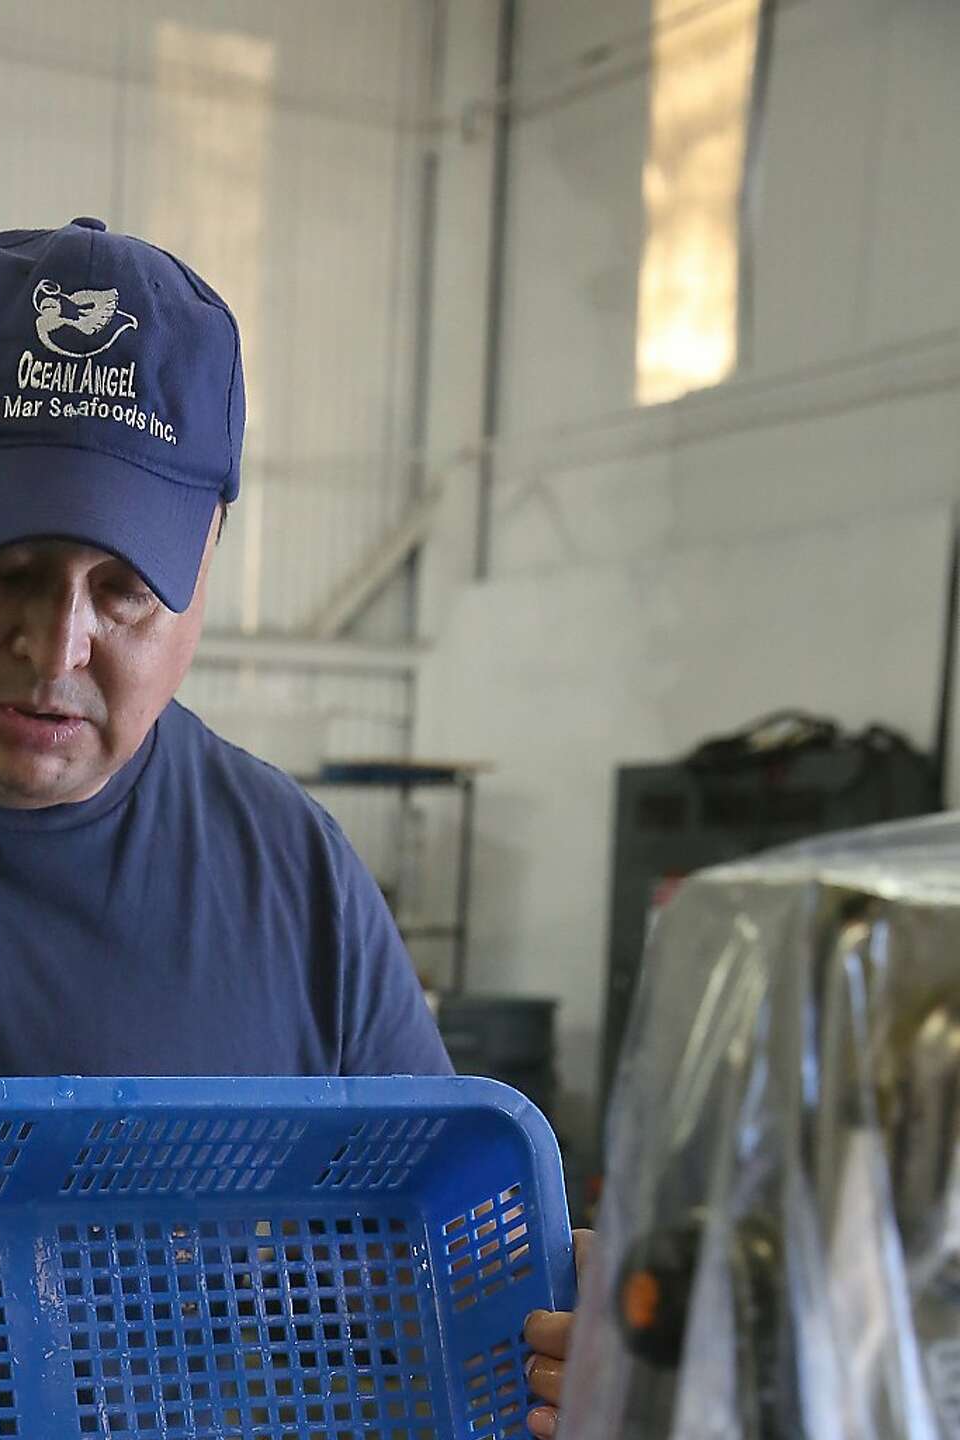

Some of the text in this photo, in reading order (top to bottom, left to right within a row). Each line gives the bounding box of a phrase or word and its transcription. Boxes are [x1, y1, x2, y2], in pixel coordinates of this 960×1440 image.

[17, 350, 136, 398] OCEAN ANGEL
[3, 395, 43, 419] Mar
[49, 397, 146, 430] Seafoods
